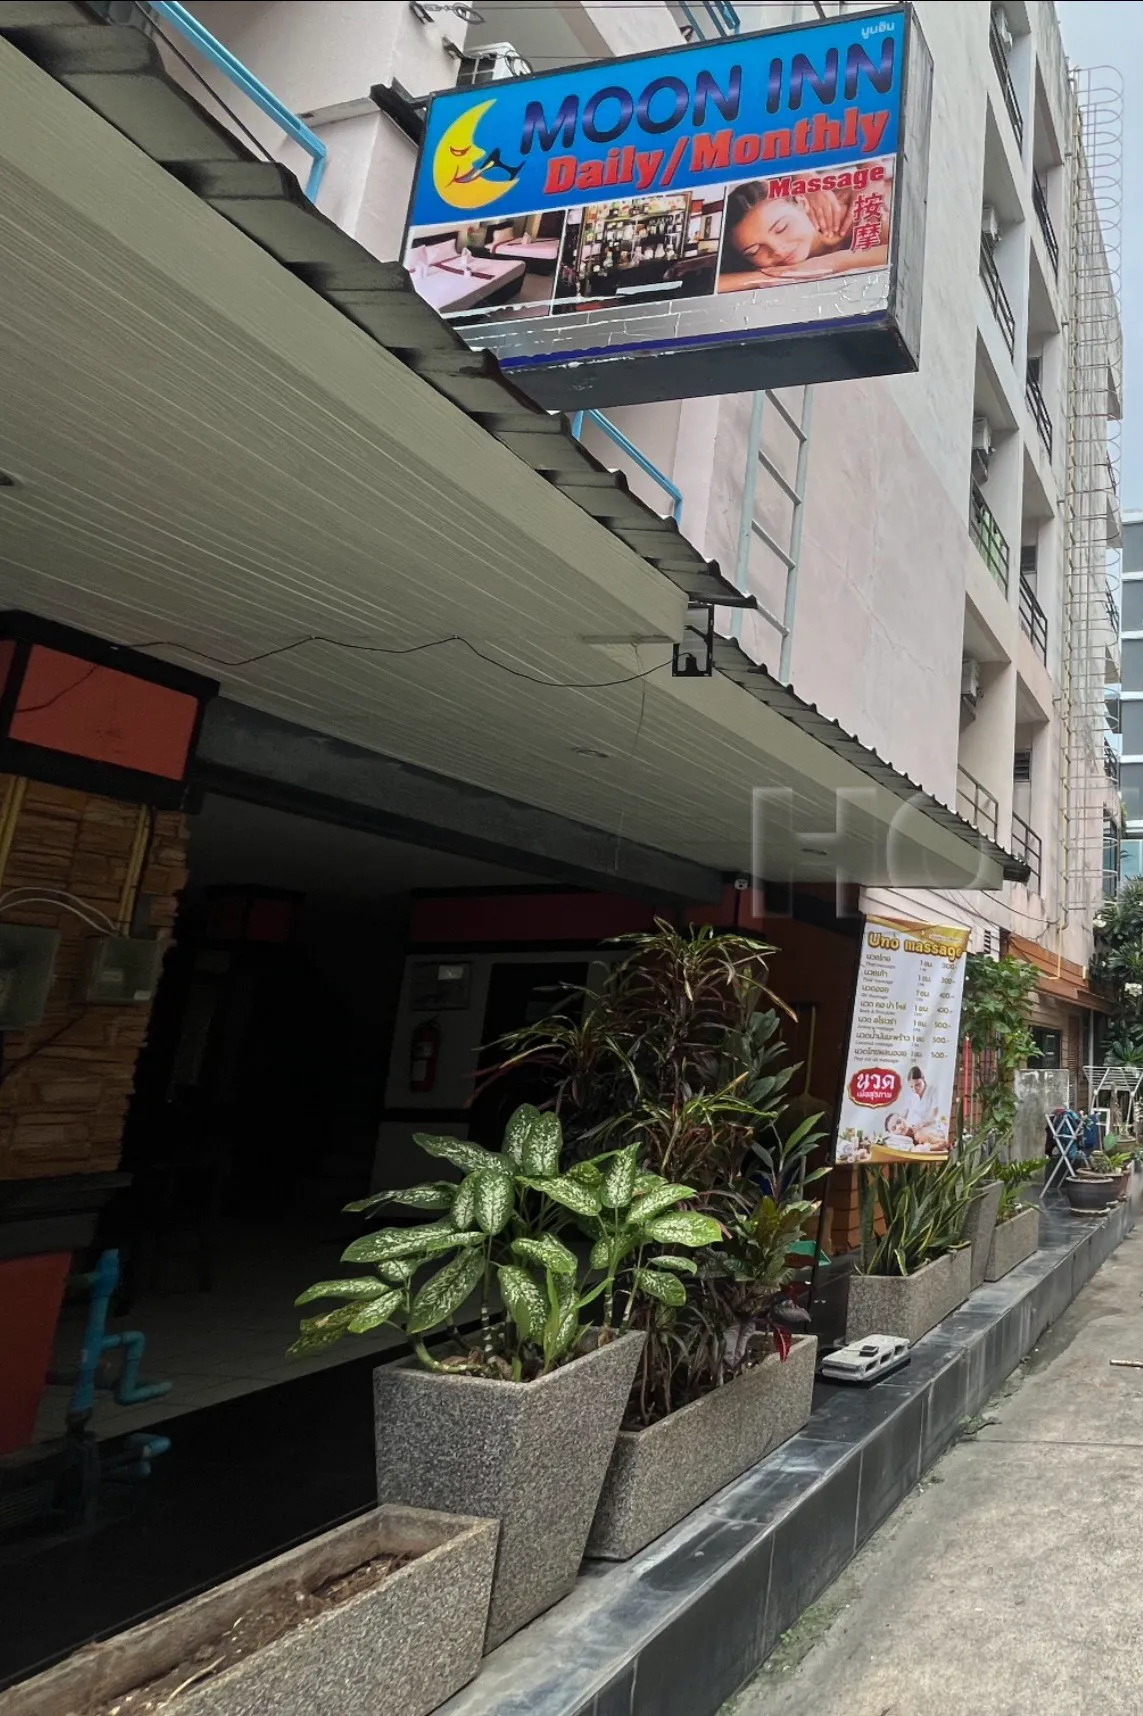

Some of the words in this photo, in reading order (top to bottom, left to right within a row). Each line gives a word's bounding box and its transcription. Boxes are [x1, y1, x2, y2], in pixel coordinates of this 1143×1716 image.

[520, 64, 743, 156] MOON
[766, 36, 894, 117] INN
[543, 106, 891, 196] Daily/Monthly
[767, 163, 886, 200] Massage
[849, 192, 887, 255] 按摩
[904, 940, 963, 962] massage
[857, 1073, 895, 1090] นวด
